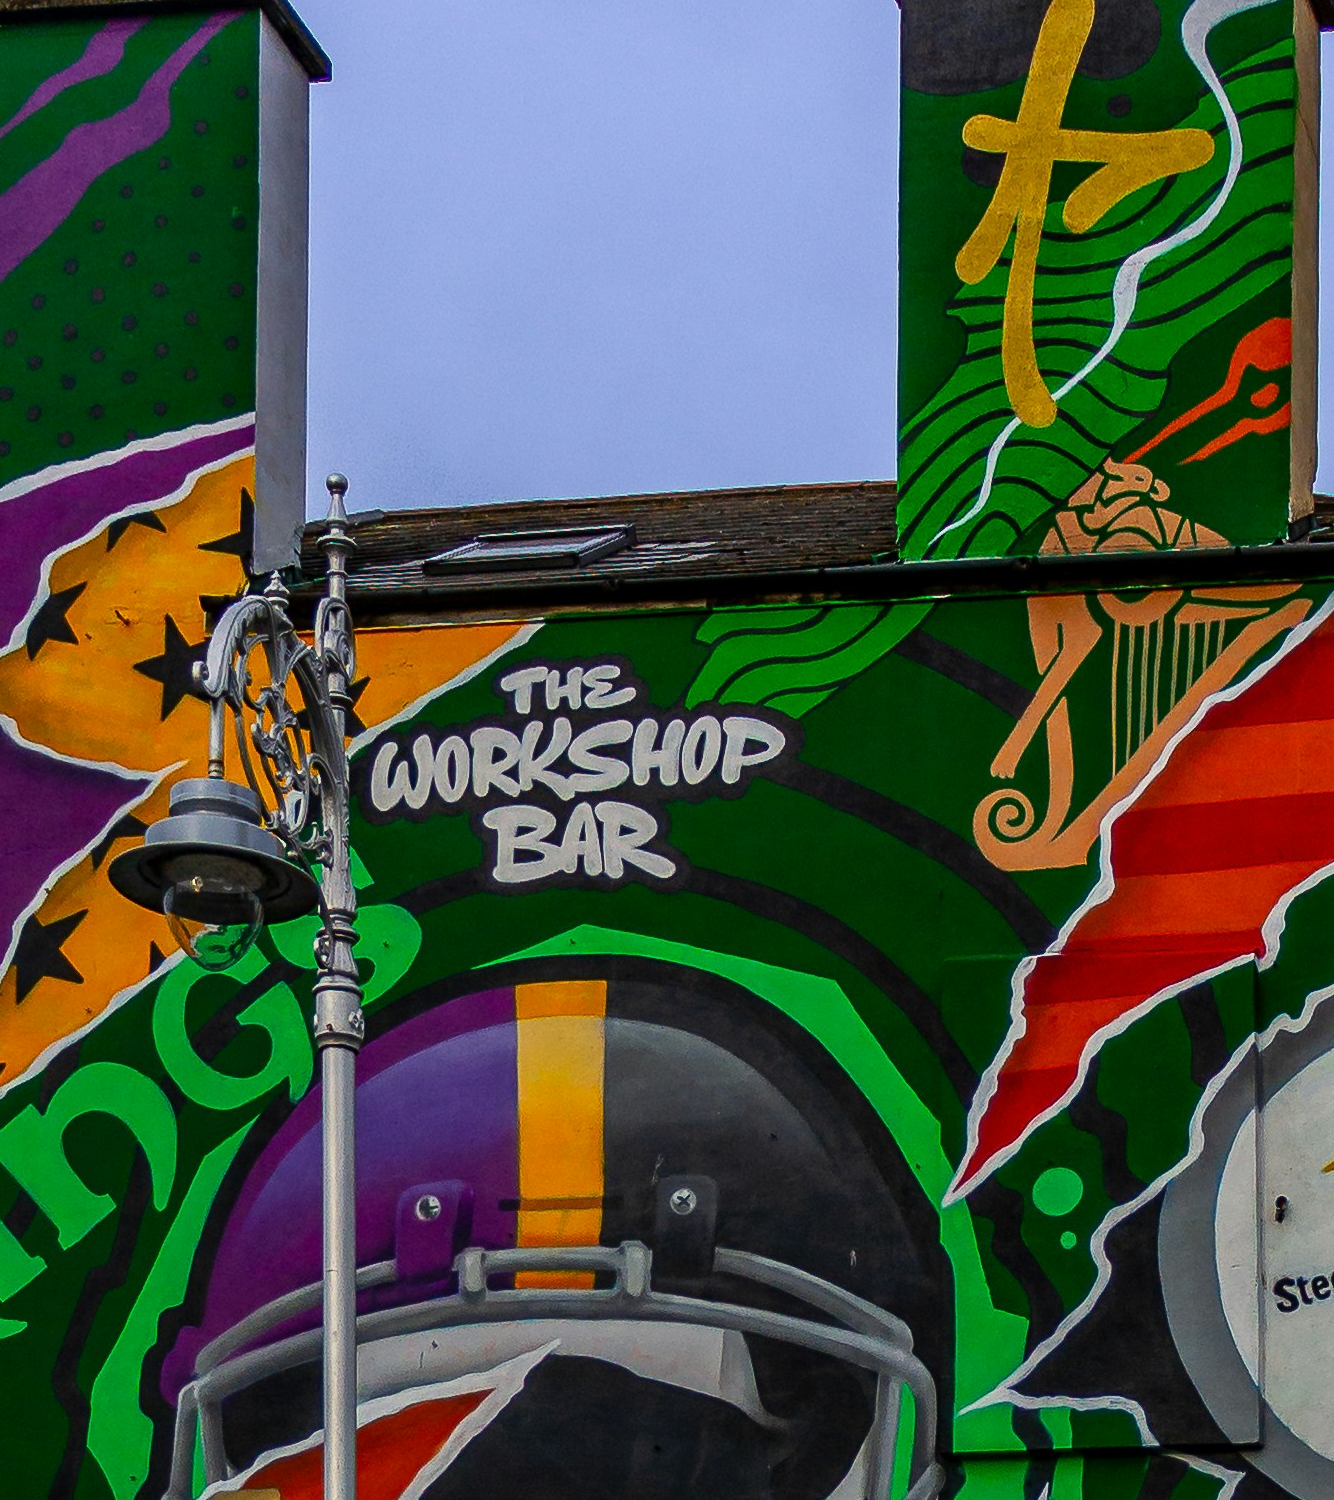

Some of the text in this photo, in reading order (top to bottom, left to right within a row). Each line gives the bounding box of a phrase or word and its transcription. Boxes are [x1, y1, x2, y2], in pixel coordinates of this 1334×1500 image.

[500, 664, 637, 715] THE
[370, 715, 786, 812] WORKSHOP
[482, 800, 677, 884] BAR
